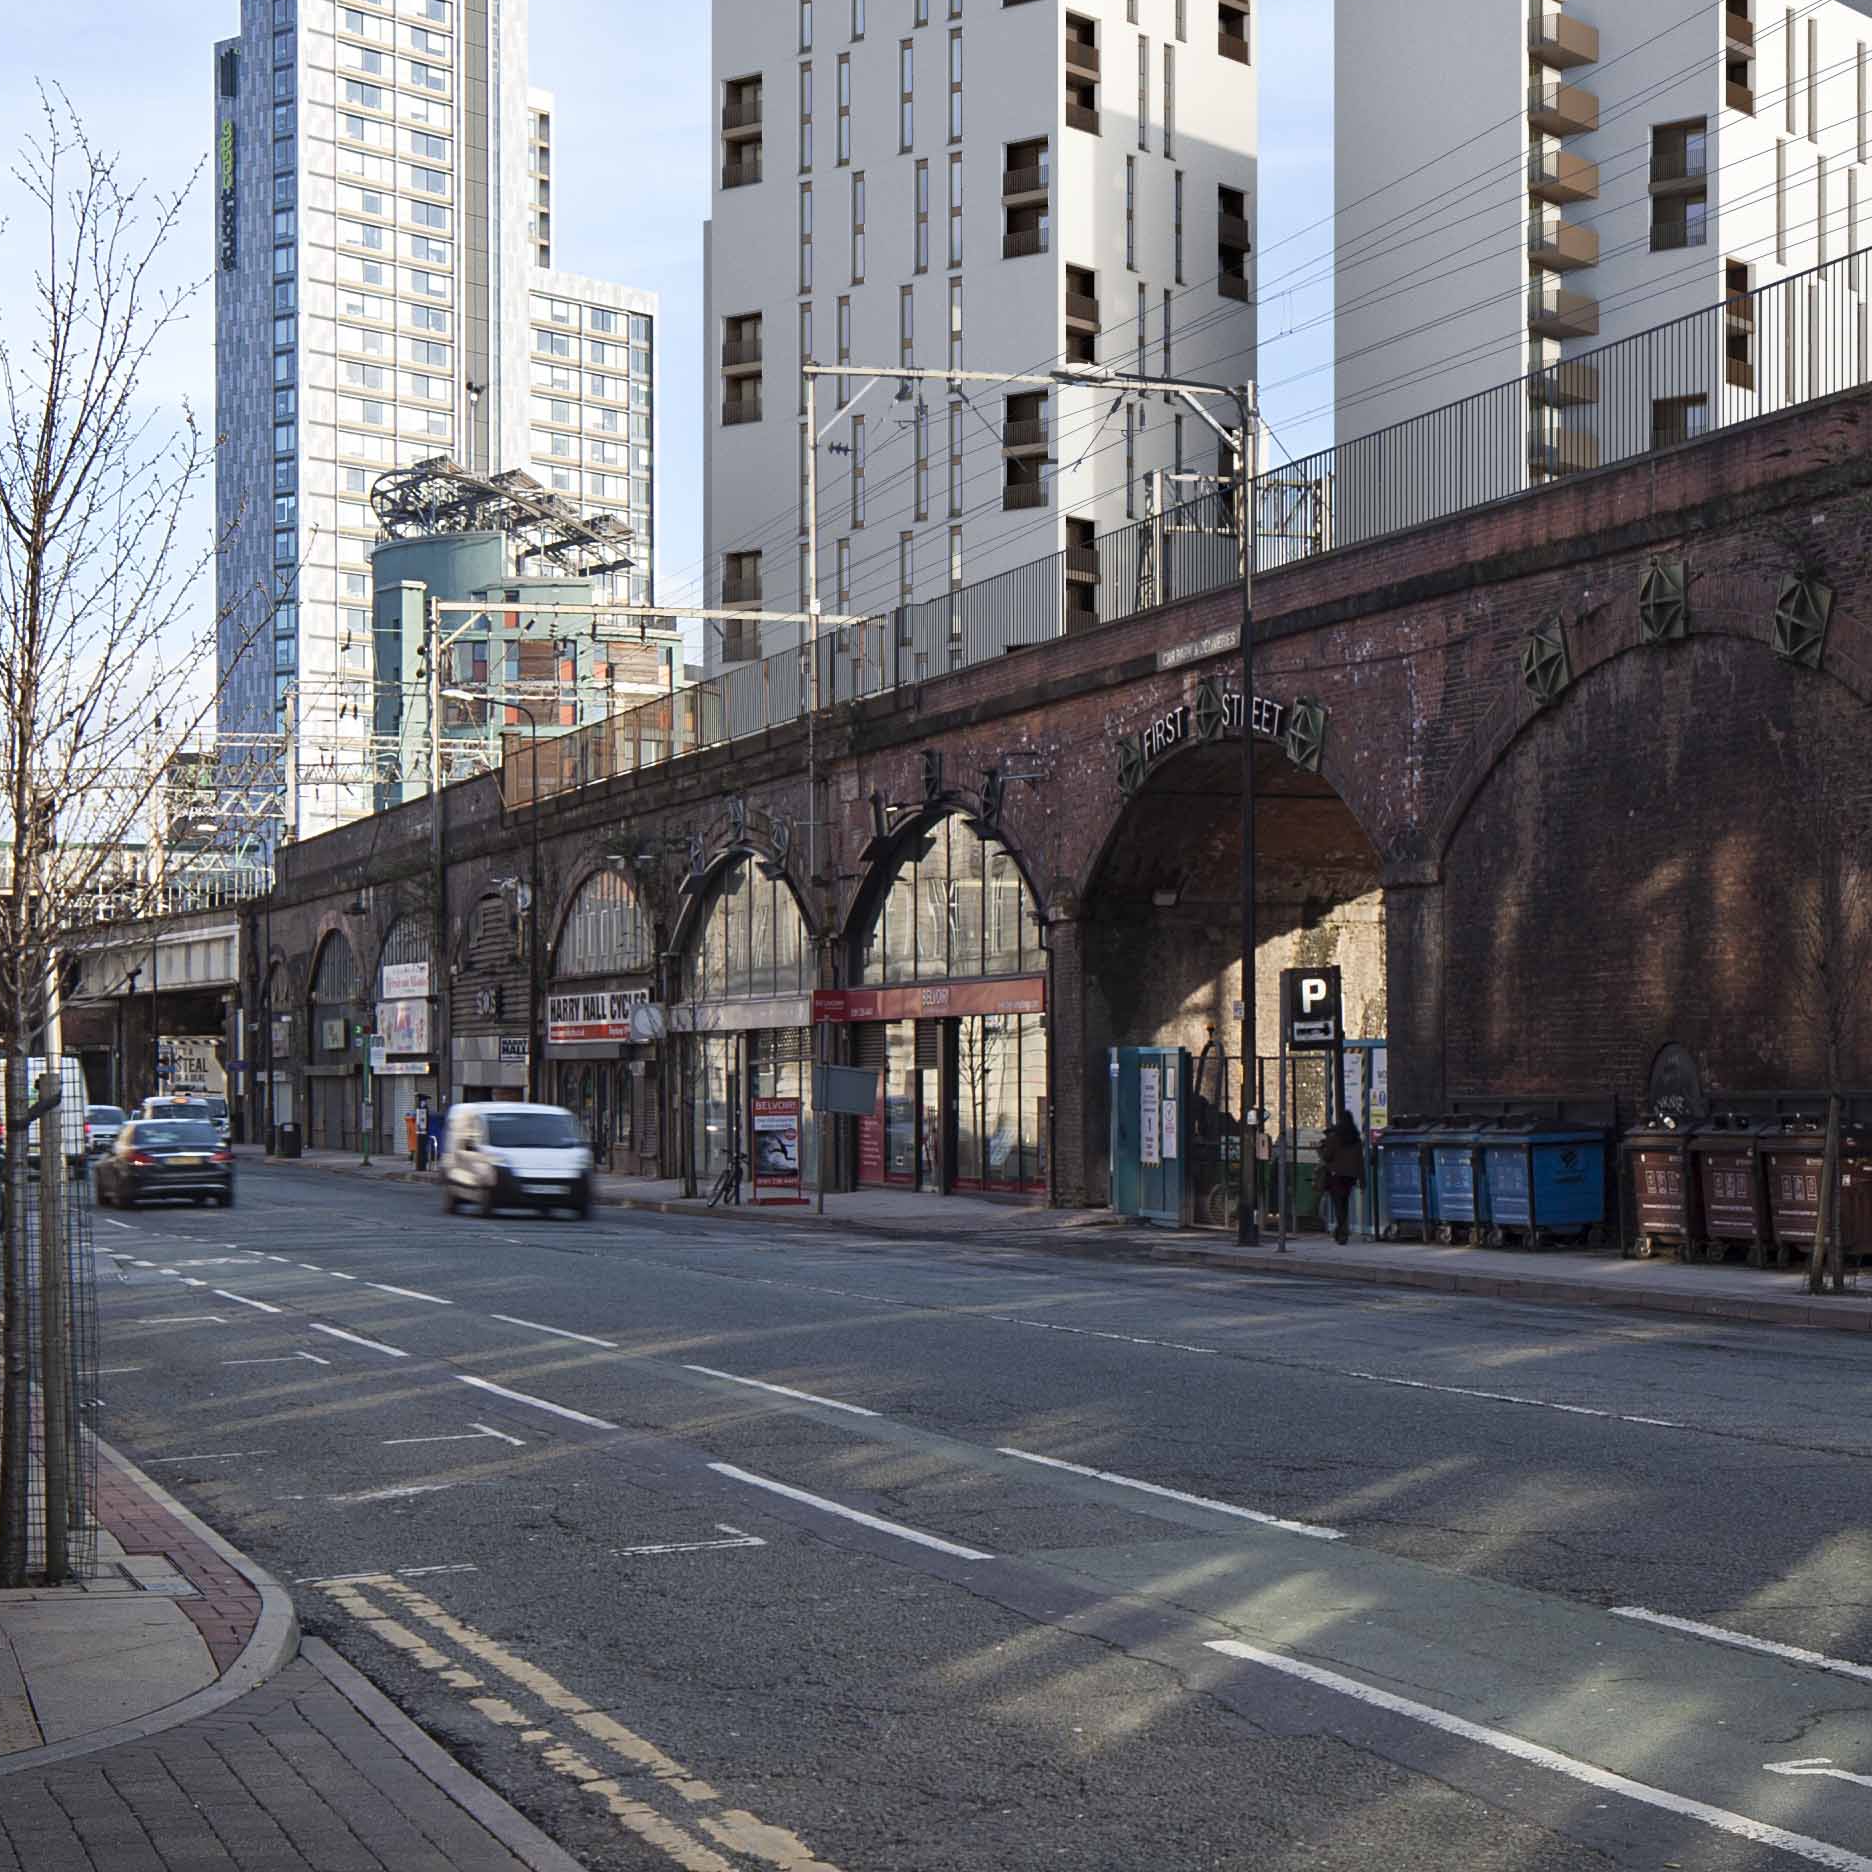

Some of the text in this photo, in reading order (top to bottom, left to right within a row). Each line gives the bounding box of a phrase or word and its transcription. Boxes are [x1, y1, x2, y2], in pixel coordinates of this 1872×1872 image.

[1143, 706, 1183, 761] FIRST
[550, 997, 580, 1022] HARRY
[583, 995, 607, 1020] HALL
[1302, 978, 1327, 1014] P
[502, 1046, 528, 1056] HALL
[175, 1057, 208, 1073] STEAL
